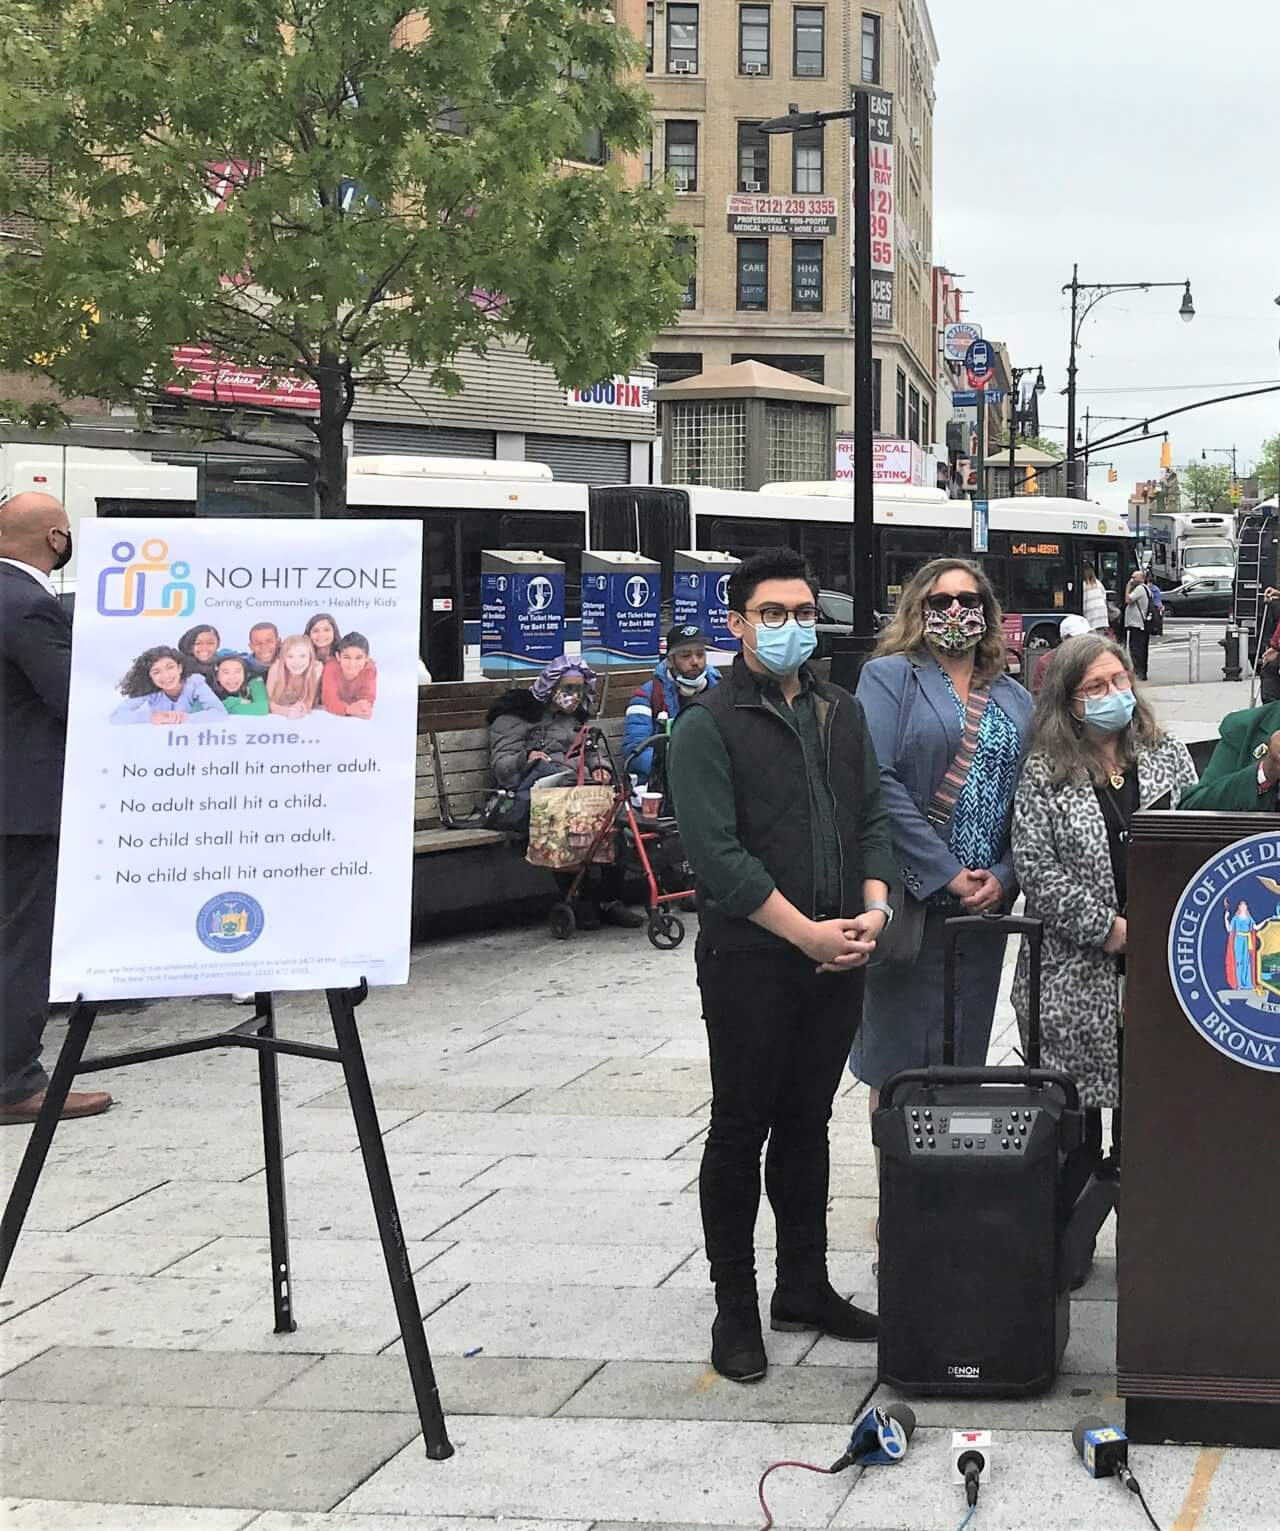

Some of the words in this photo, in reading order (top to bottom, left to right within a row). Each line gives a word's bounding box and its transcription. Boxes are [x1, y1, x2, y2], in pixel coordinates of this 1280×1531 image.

[870, 96, 892, 116] EAST
[877, 118, 890, 137] ST.
[874, 171, 892, 185] RAY
[756, 200, 782, 214] (212)
[786, 200, 806, 214] 239
[808, 200, 834, 214] 3355
[737, 216, 782, 224] PROFESSIONAL
[790, 217, 827, 225] NON-PROFIT
[734, 224, 761, 232] MEDICAL
[768, 224, 787, 232] LEGAL
[742, 264, 765, 272] CARE
[797, 265, 819, 273] HHA
[798, 290, 818, 298] LPN
[1072, 520, 1088, 530] 5770
[206, 567, 252, 588] NO
[262, 567, 308, 588] HIT
[316, 568, 398, 588] ZONE
[204, 597, 242, 610] Caring
[246, 596, 320, 608] Communities
[328, 597, 370, 609] Healthy
[374, 597, 398, 608] Kids
[518, 614, 530, 622] Get
[530, 614, 548, 622] Ticket
[548, 614, 562, 622] Here
[168, 730, 188, 746] In
[198, 730, 238, 746] this
[246, 733, 320, 745] zone...
[122, 764, 148, 778] No
[154, 762, 196, 778] adult
[201, 762, 239, 776] shall
[244, 762, 264, 776] hit
[270, 760, 332, 775] another
[337, 758, 381, 774] adult.
[120, 799, 146, 814] No
[152, 798, 194, 812] adult
[200, 796, 237, 812] shall
[243, 796, 263, 810] hit
[268, 798, 278, 810] a
[284, 794, 327, 808] child.
[118, 834, 144, 849] No
[150, 832, 189, 848] child
[194, 831, 232, 846] shall
[239, 830, 258, 844] hit
[264, 832, 285, 844] an
[290, 828, 336, 843] adult.
[116, 870, 142, 884] No
[147, 868, 187, 883] child
[193, 866, 231, 882] shall
[237, 865, 257, 880] hit
[262, 863, 326, 878] another
[330, 861, 373, 876] child.
[1178, 907, 1202, 985] OFFICE
[1192, 876, 1216, 906] OF
[1213, 848, 1256, 886] THE
[1202, 1010, 1278, 1064] BRONX
[948, 1366, 980, 1376] DENON
